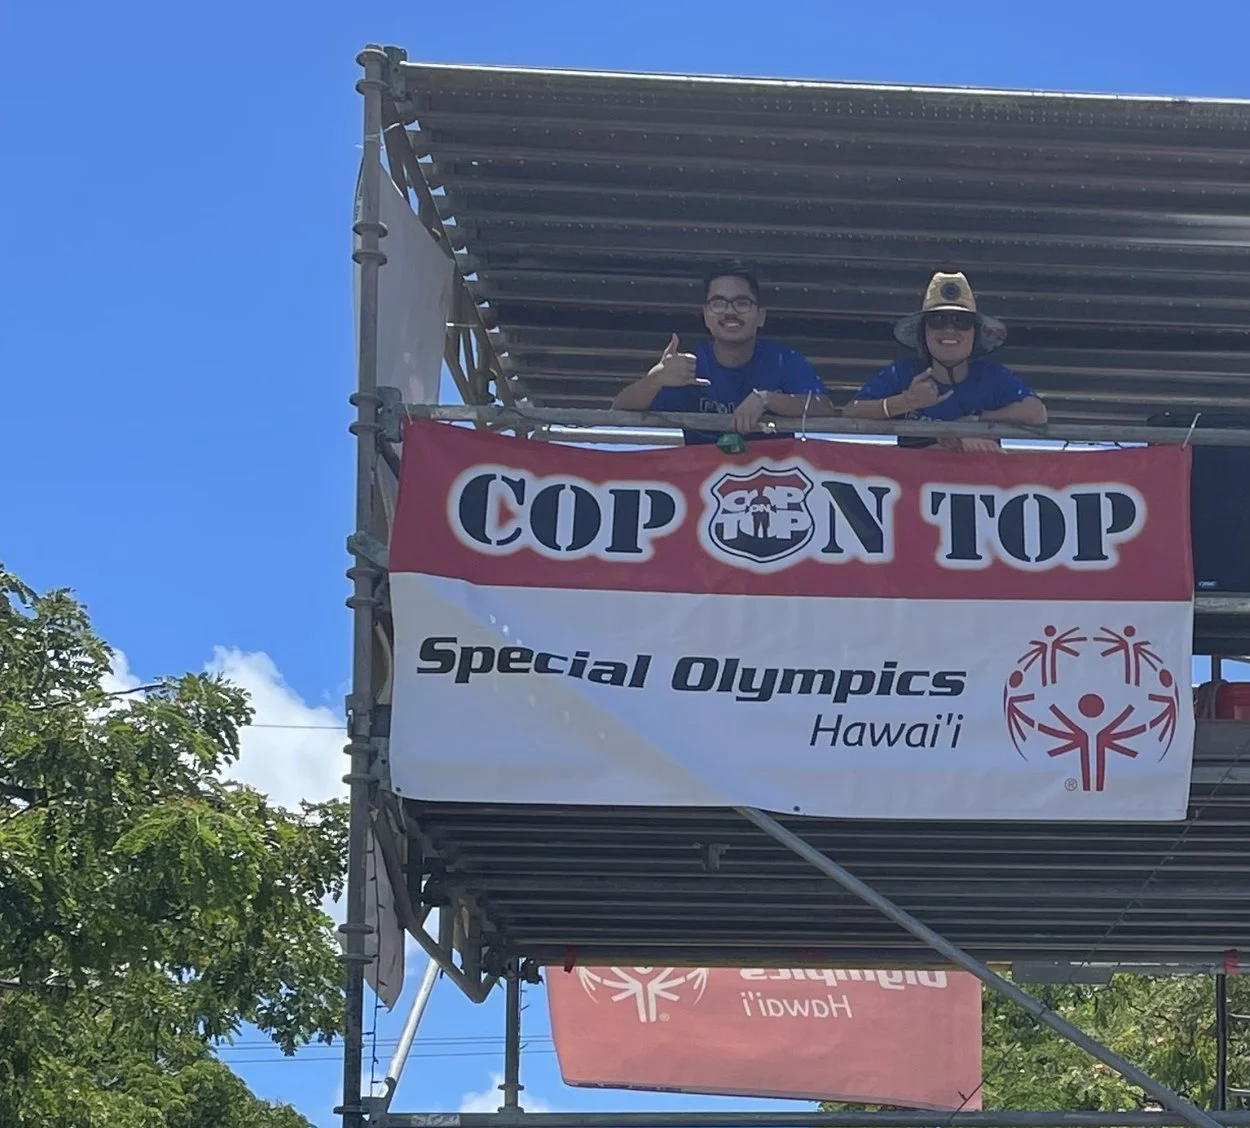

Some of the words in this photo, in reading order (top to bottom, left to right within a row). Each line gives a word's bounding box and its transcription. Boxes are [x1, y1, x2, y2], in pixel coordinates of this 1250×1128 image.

[458, 472, 677, 554] COP
[929, 489, 1138, 563] TOP
[416, 635, 654, 690] Special
[670, 655, 967, 703] Olympics
[809, 712, 964, 749] Hawai'i
